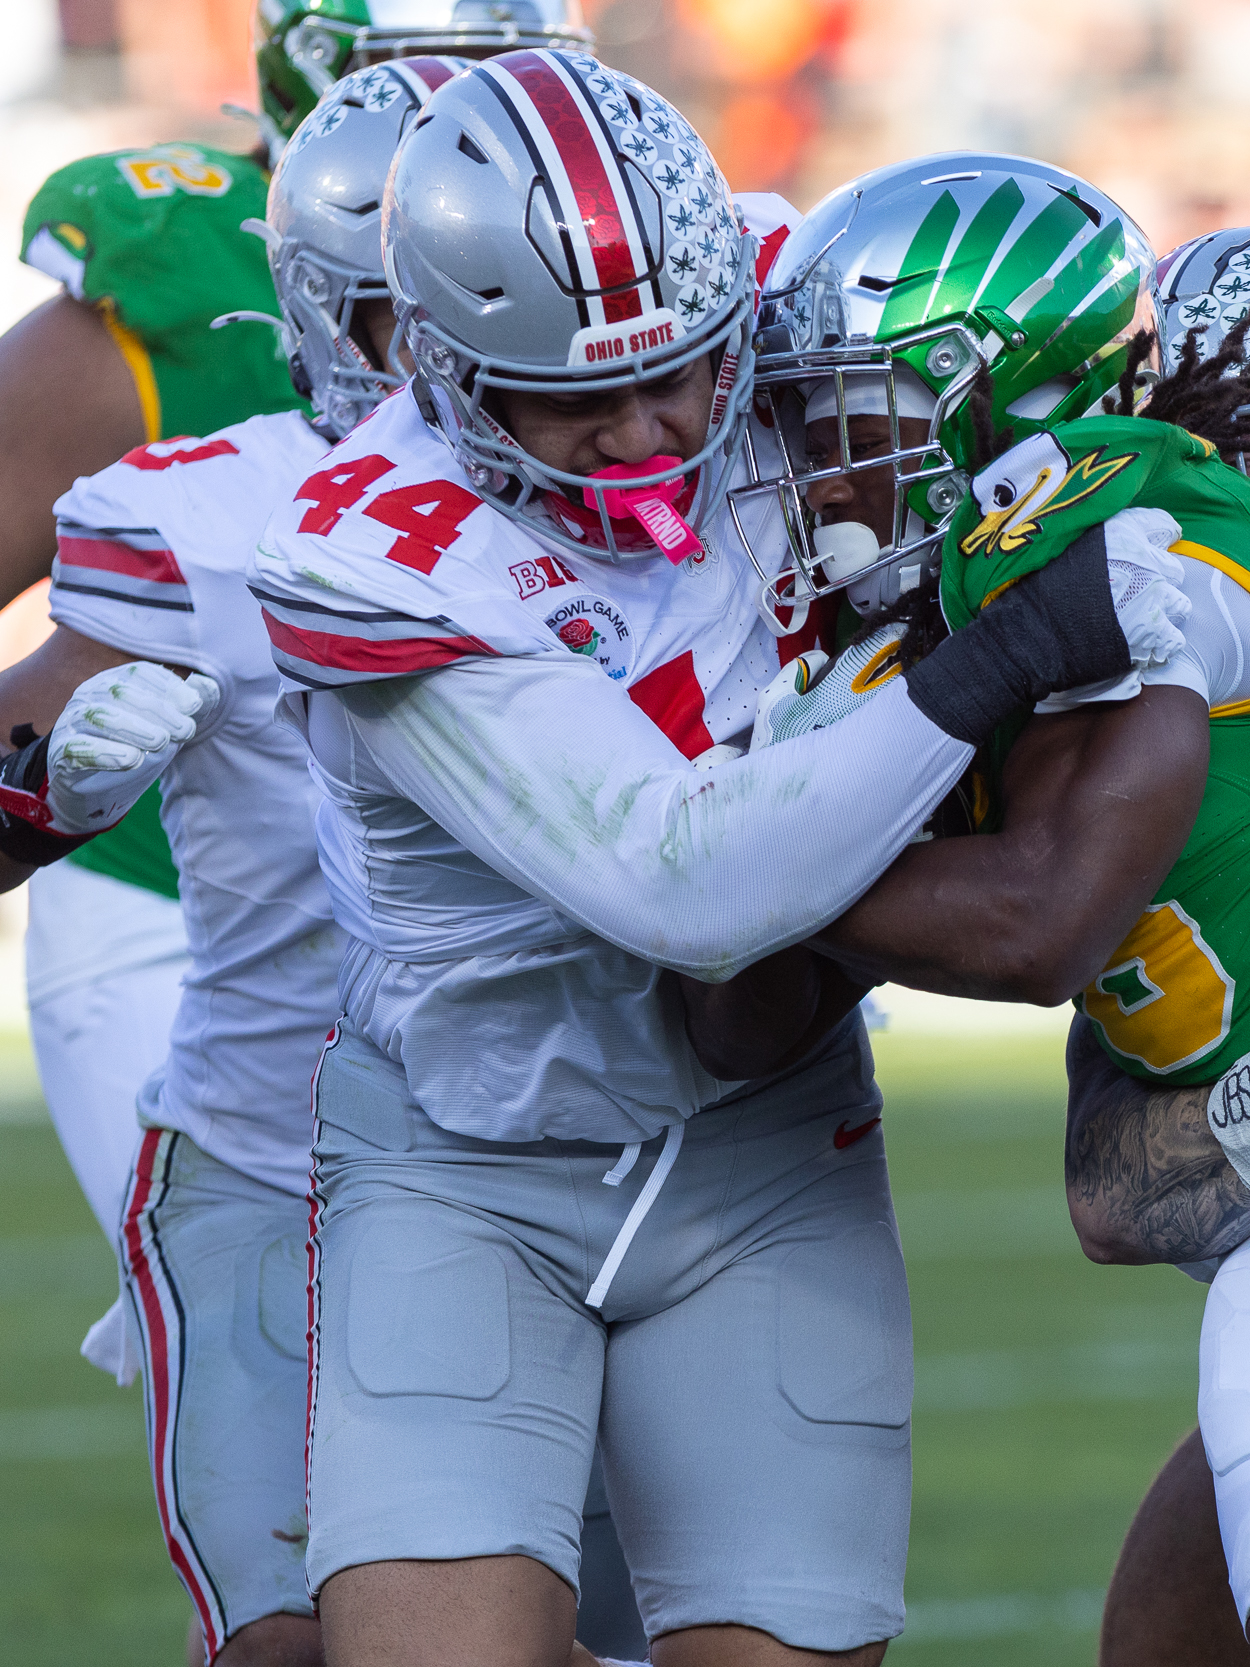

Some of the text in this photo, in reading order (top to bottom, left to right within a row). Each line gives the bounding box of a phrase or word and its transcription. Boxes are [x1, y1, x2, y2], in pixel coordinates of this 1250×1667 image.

[584, 321, 675, 363] OHIO STATE
[711, 351, 739, 425] OHIO STATE
[292, 453, 486, 577] 44
[545, 600, 630, 642] BOWL GAME
